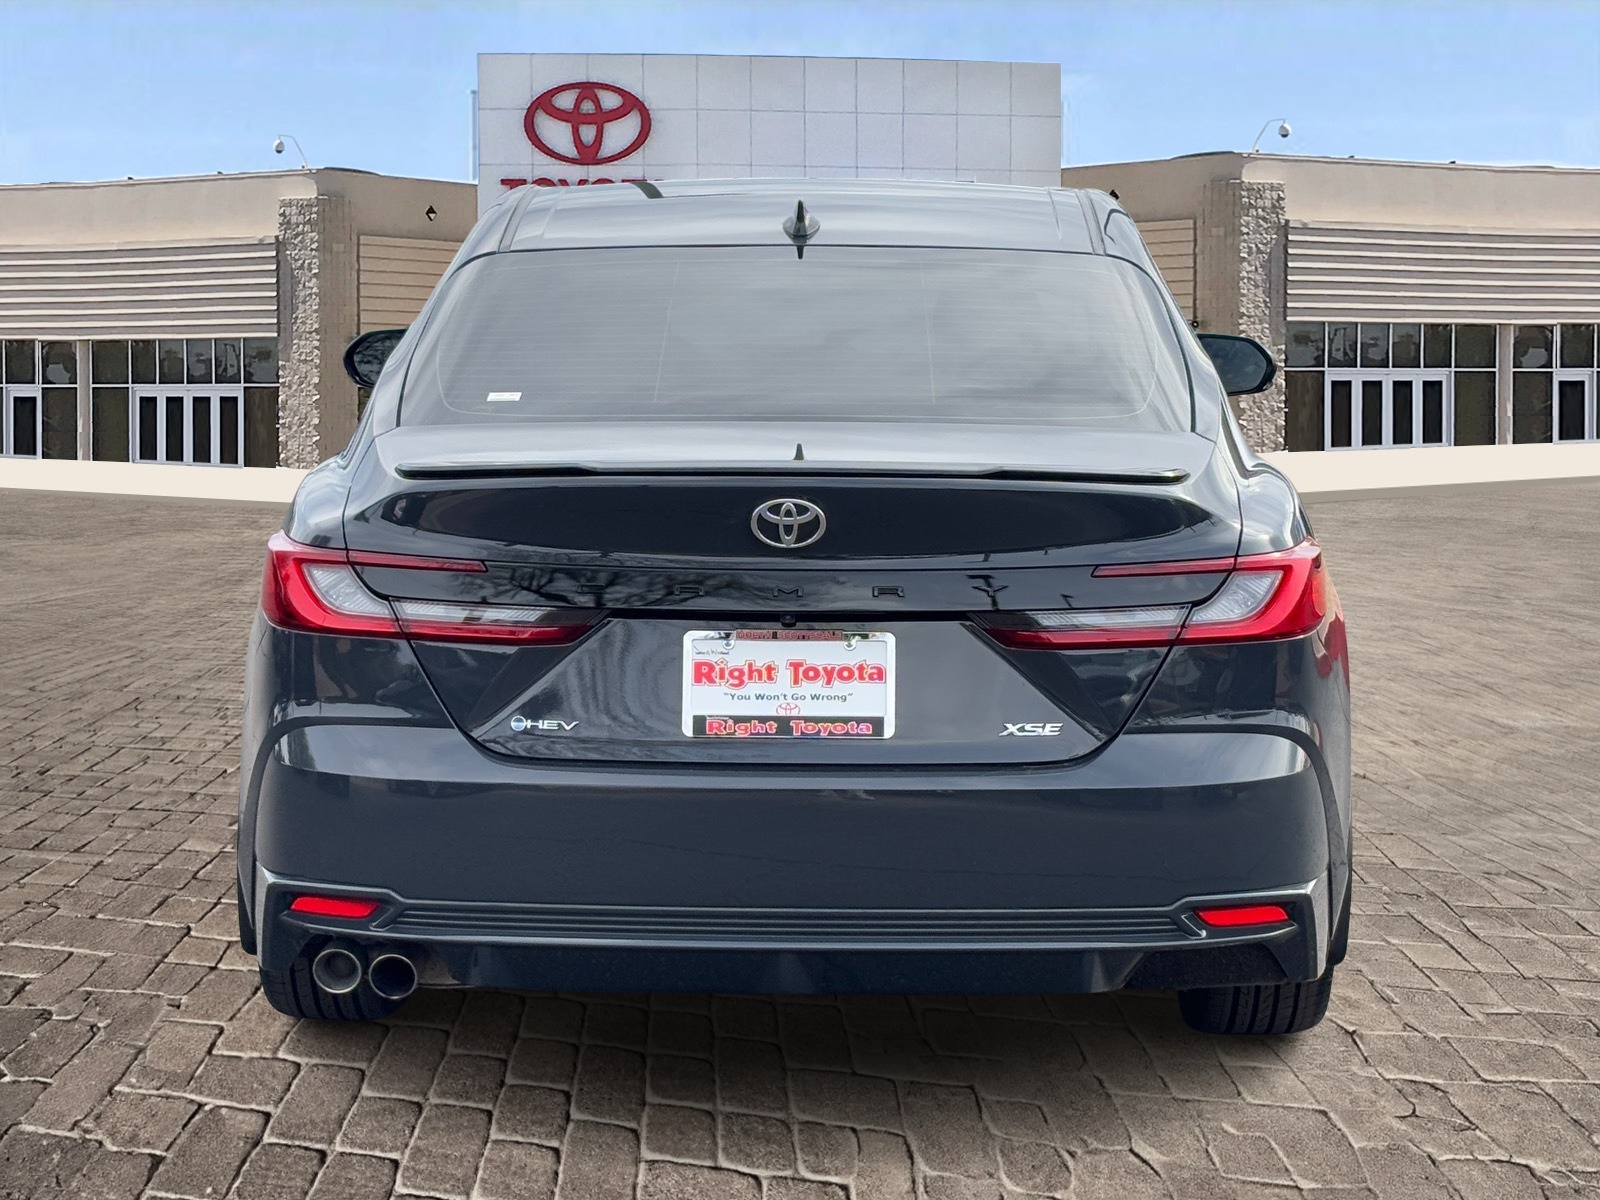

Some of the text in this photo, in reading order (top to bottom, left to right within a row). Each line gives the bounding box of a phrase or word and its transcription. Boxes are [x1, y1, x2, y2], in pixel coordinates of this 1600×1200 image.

[692, 658, 887, 689] Right Toyota
[755, 692, 787, 701] Won't
[791, 692, 807, 701] Go
[526, 719, 579, 730] HEV
[706, 719, 872, 736] Right Toyota
[998, 723, 1063, 736] XSE
